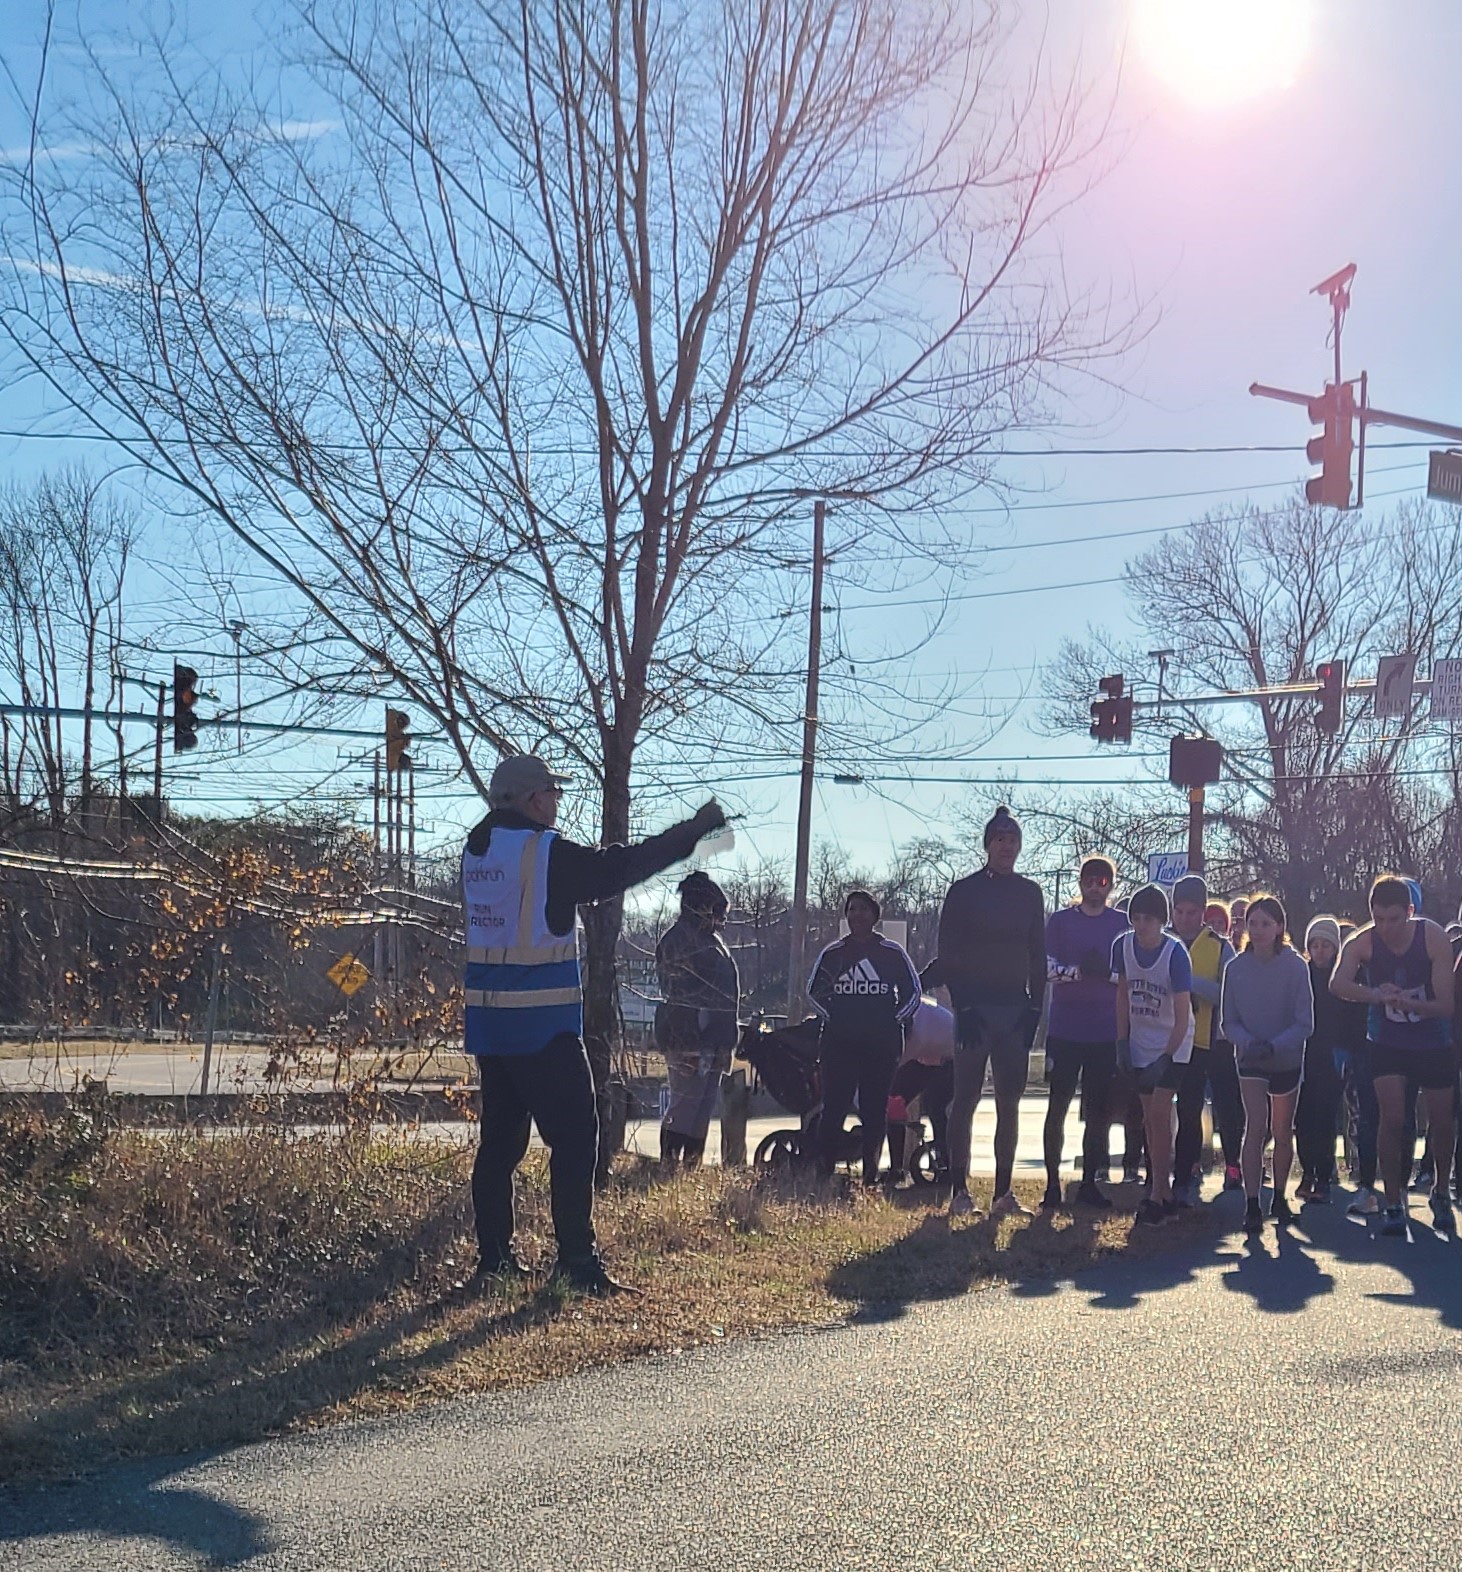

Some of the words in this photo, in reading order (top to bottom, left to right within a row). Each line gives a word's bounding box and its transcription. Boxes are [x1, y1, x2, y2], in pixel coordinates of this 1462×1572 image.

[1445, 661, 1462, 673] NO
[1379, 700, 1406, 713] ONLY
[1433, 697, 1446, 708] ON
[834, 980, 889, 995] adidas
